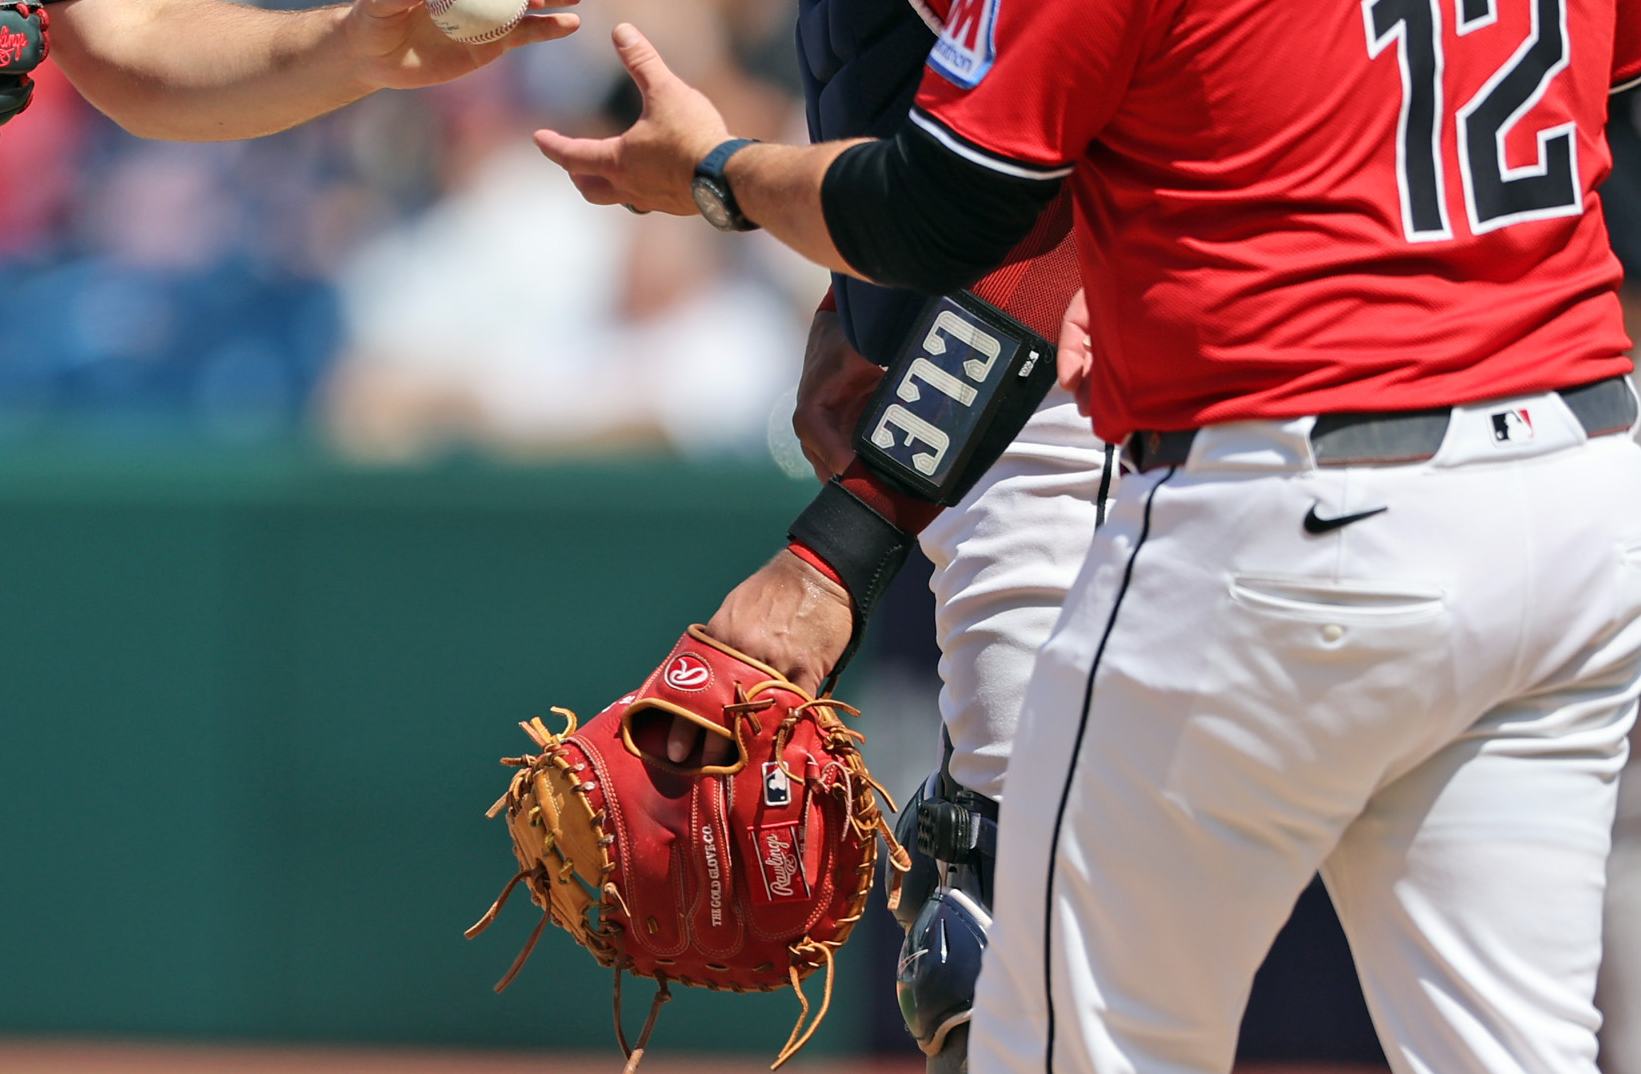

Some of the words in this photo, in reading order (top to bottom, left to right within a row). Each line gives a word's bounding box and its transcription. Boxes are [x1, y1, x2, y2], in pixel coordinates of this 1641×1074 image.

[870, 310, 1001, 476] CLE
[704, 845, 720, 879] GLOVE
[765, 833, 794, 897] Rawlings
[710, 880, 722, 908] GOLD
[711, 909, 722, 926] THE
